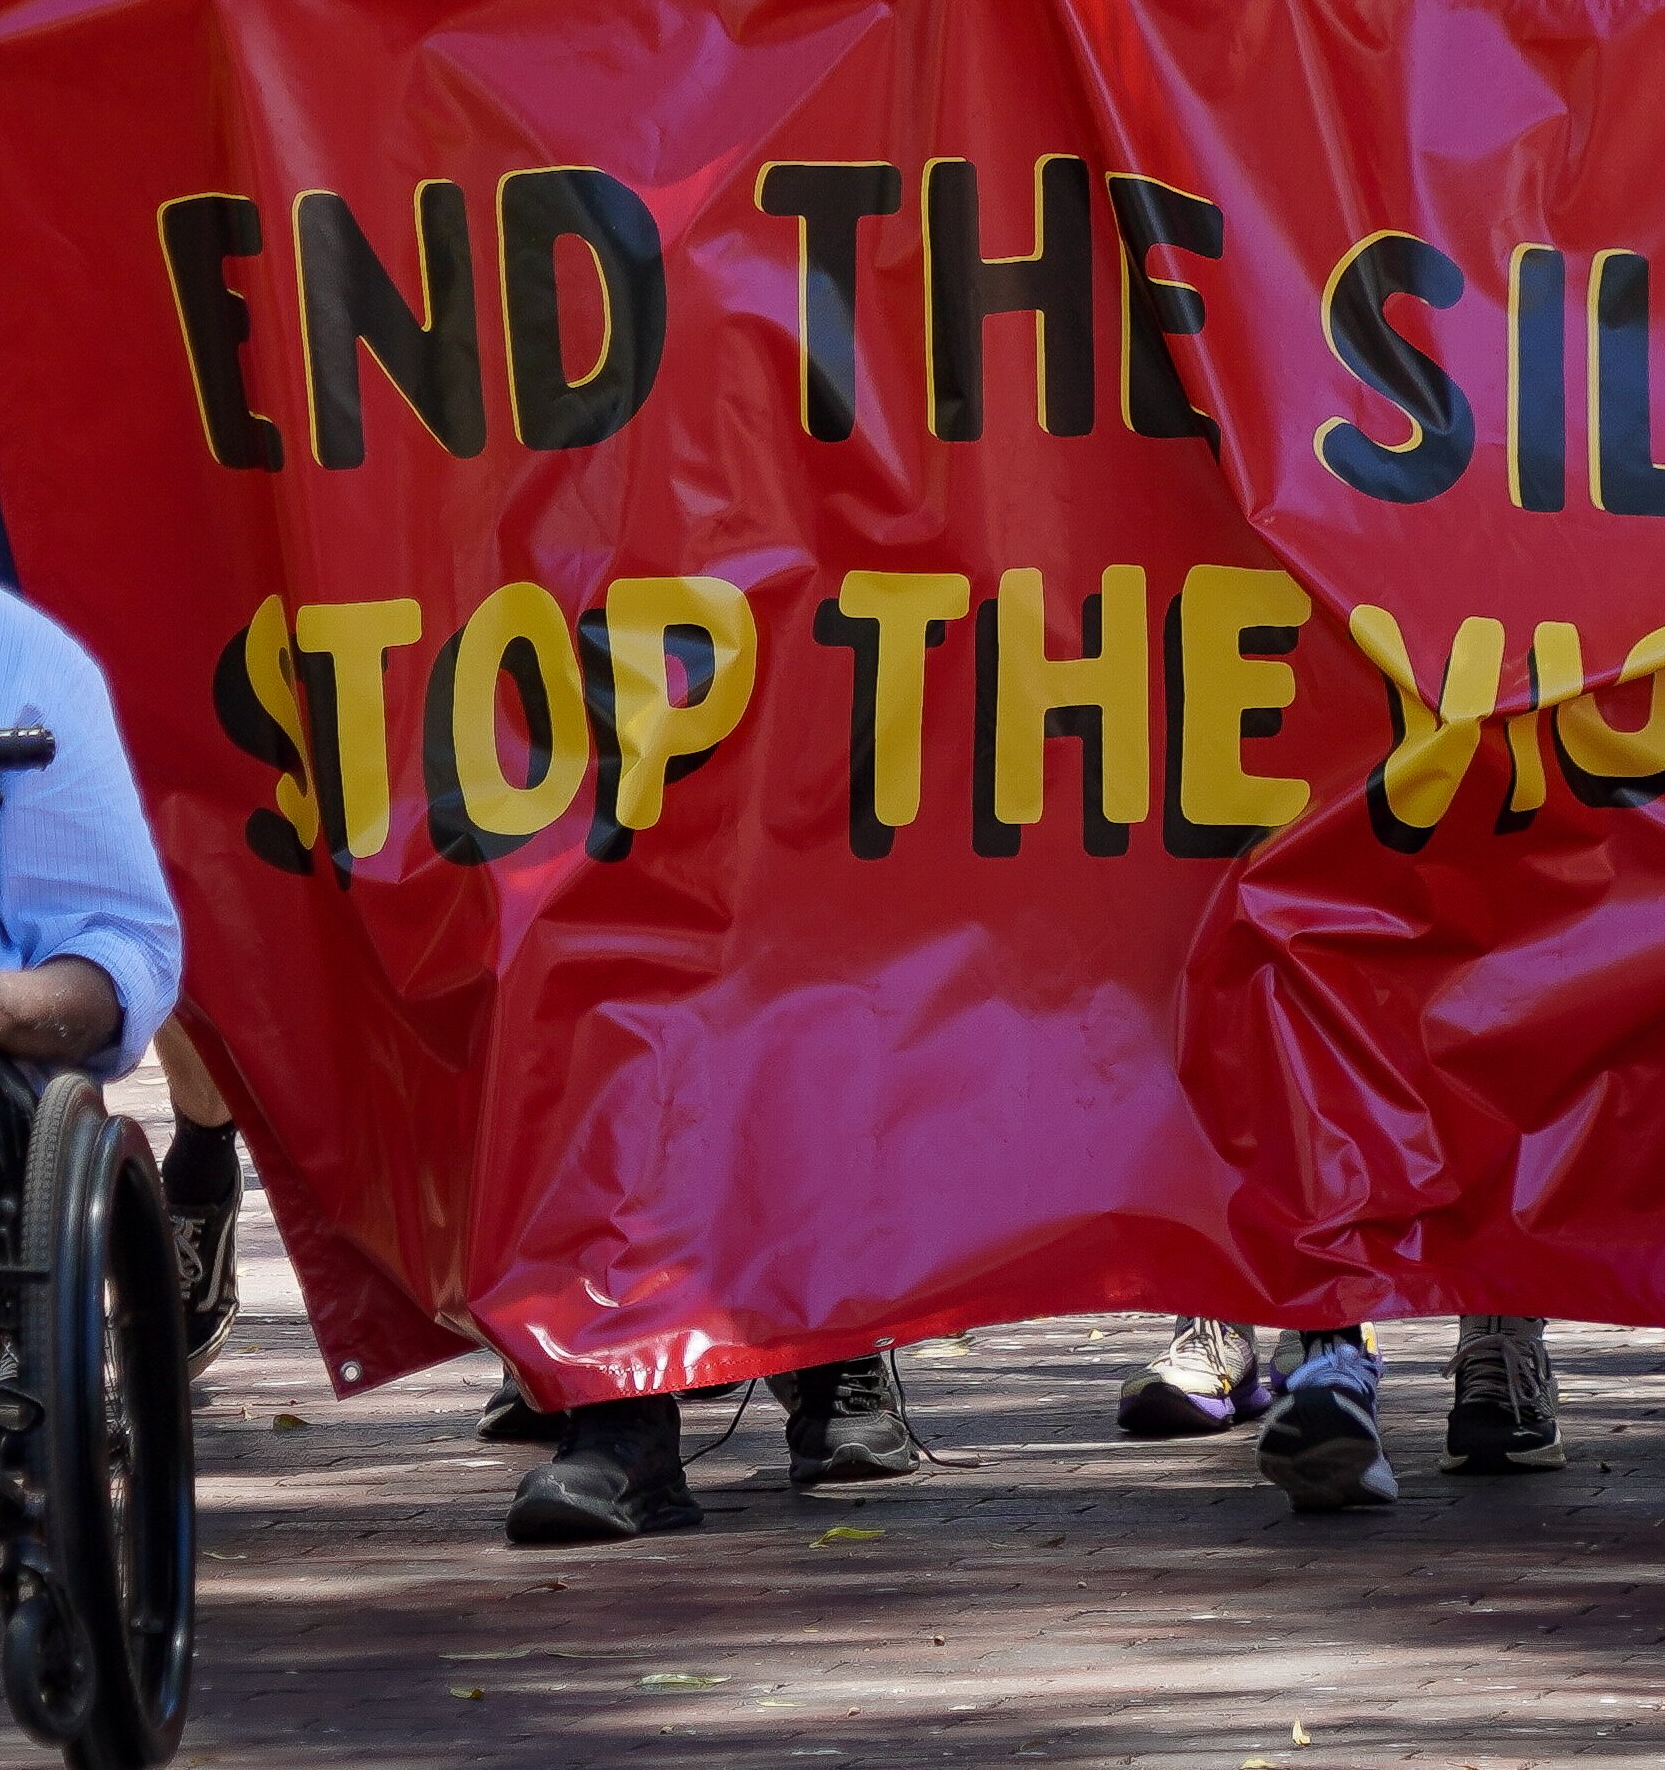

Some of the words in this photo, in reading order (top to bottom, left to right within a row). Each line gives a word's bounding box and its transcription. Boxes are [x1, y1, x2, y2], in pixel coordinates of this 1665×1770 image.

[157, 165, 668, 472] END
[754, 153, 1223, 461] THE
[212, 575, 759, 890] STOP
[813, 564, 1313, 860] THE
